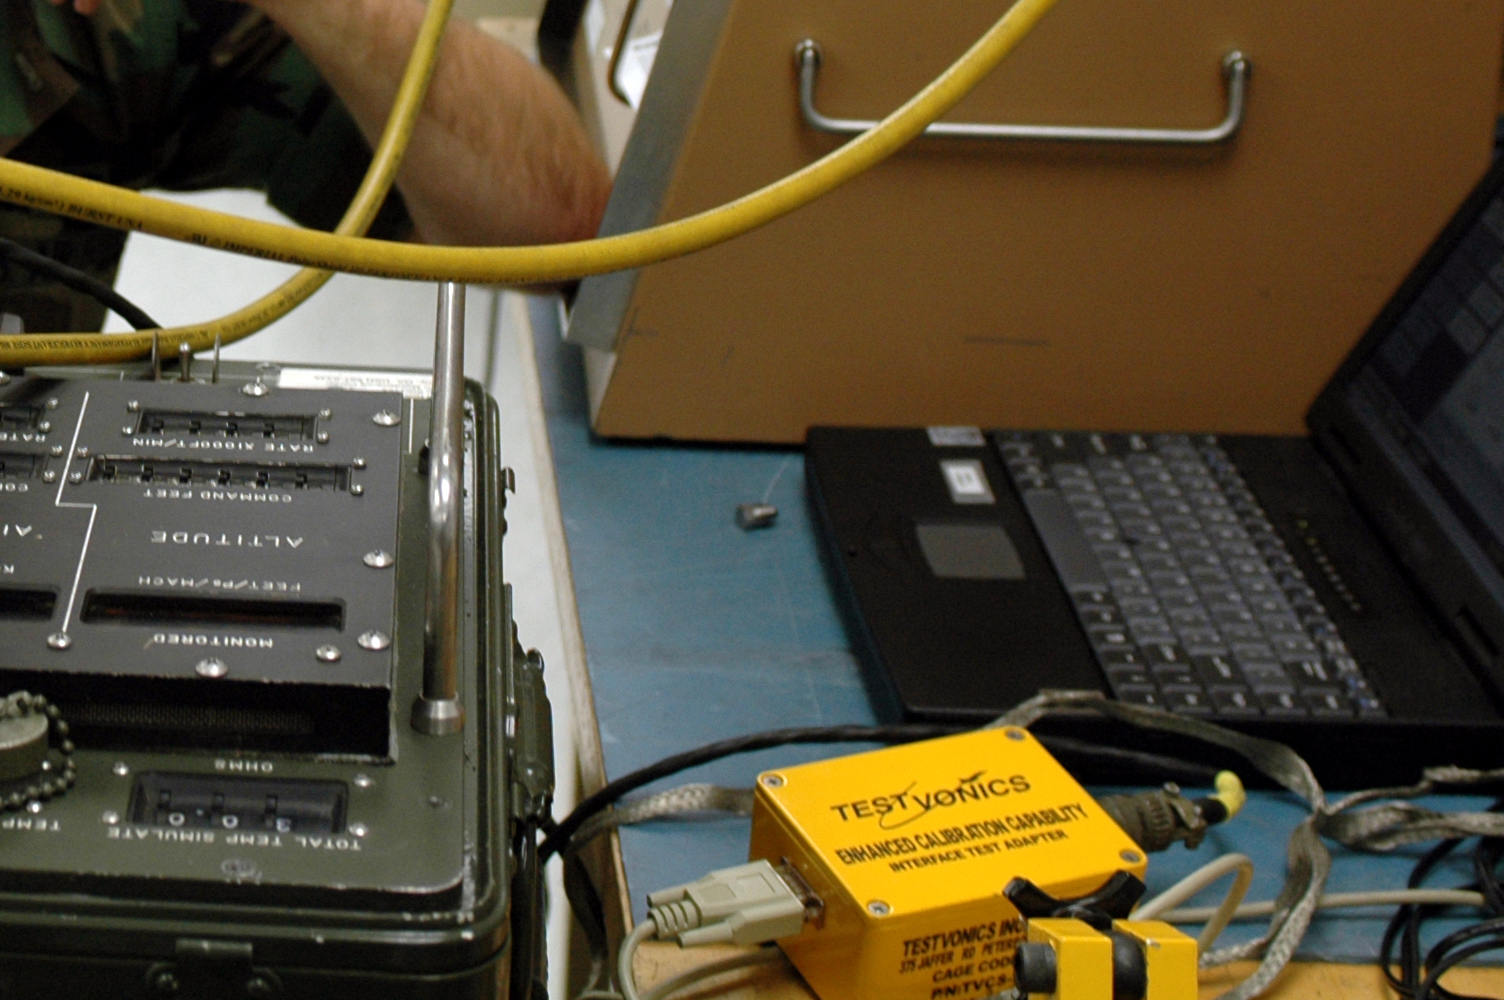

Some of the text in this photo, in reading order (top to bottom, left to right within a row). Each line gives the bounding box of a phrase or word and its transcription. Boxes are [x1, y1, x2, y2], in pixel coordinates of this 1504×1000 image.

[66, 201, 112, 221] BURST
[265, 442, 314, 454] RATE
[143, 488, 293, 503] COMMAND FEET
[151, 530, 304, 550] ALTITUDE
[153, 633, 274, 649] MONITORED
[214, 760, 273, 772] OHMS
[2, 818, 61, 832] TEMP
[834, 803, 1089, 866] ENHANCED CALIBRATION CAPABILITY
[106, 826, 362, 851] TOTAL TEMP SIMULATE
[888, 830, 1069, 873] INTERFACE TEST ADAPTER
[903, 921, 998, 957] TESTVONICS
[932, 963, 974, 982] CAGE
